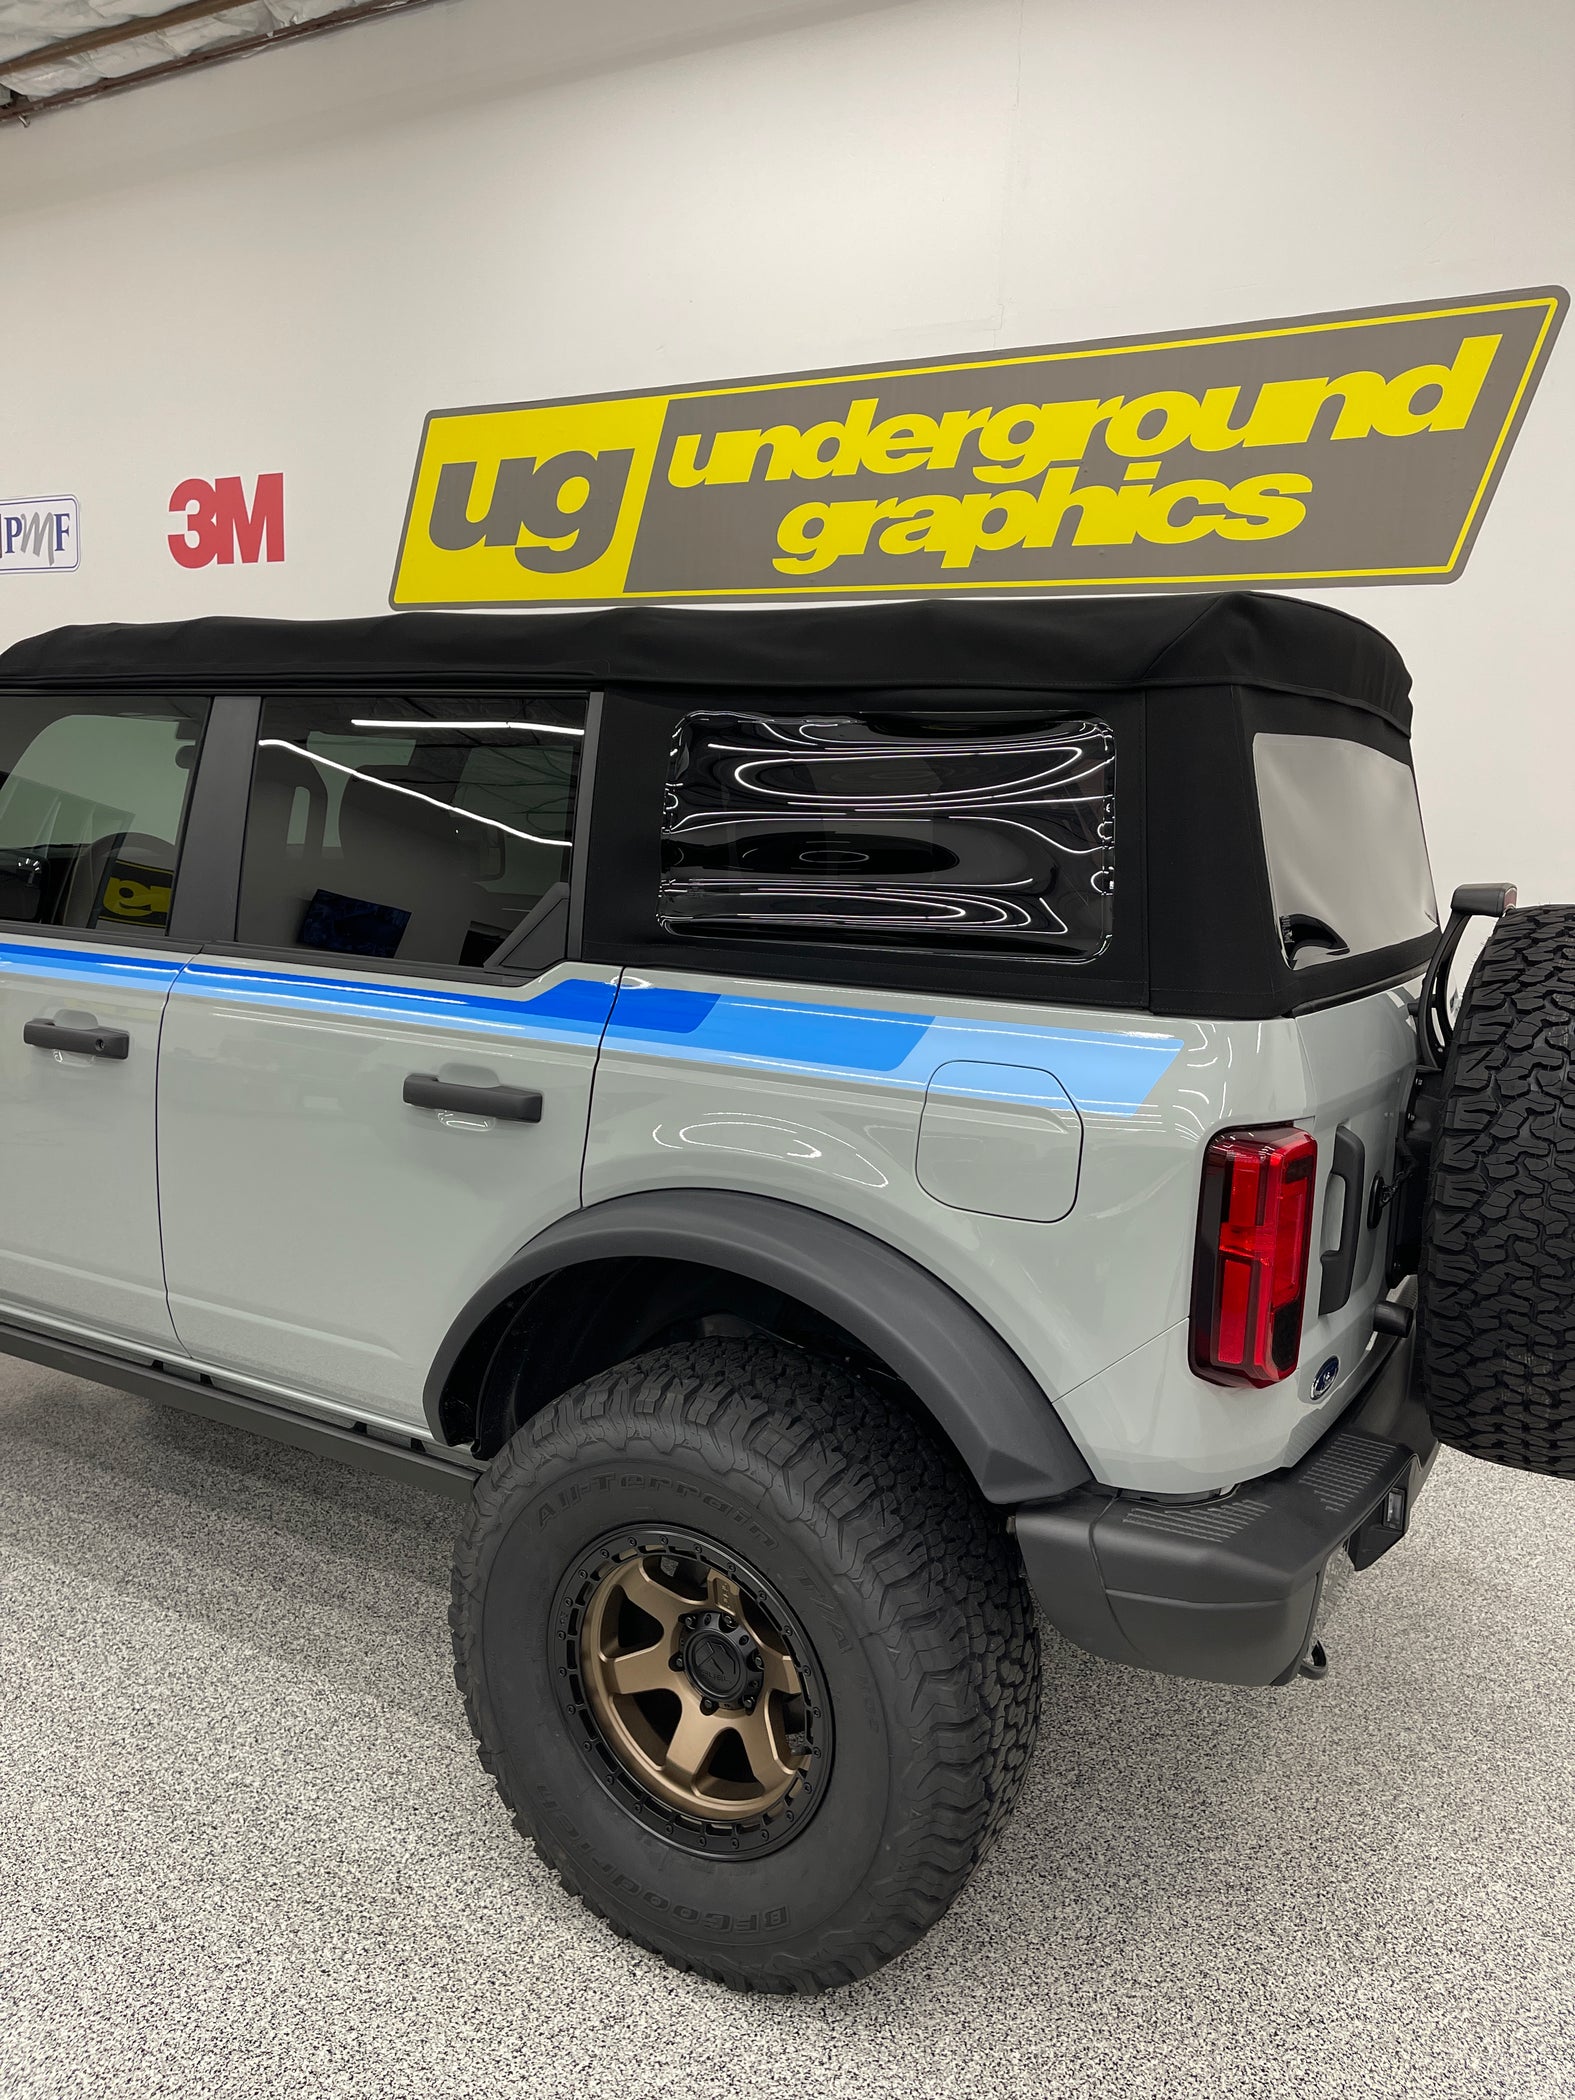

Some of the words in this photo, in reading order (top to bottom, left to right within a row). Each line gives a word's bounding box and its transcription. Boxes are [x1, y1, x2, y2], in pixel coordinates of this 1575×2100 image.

[667, 333, 1503, 489] underground
[167, 472, 285, 569] 3M
[429, 448, 635, 574] ug
[771, 460, 1313, 576] graphics
